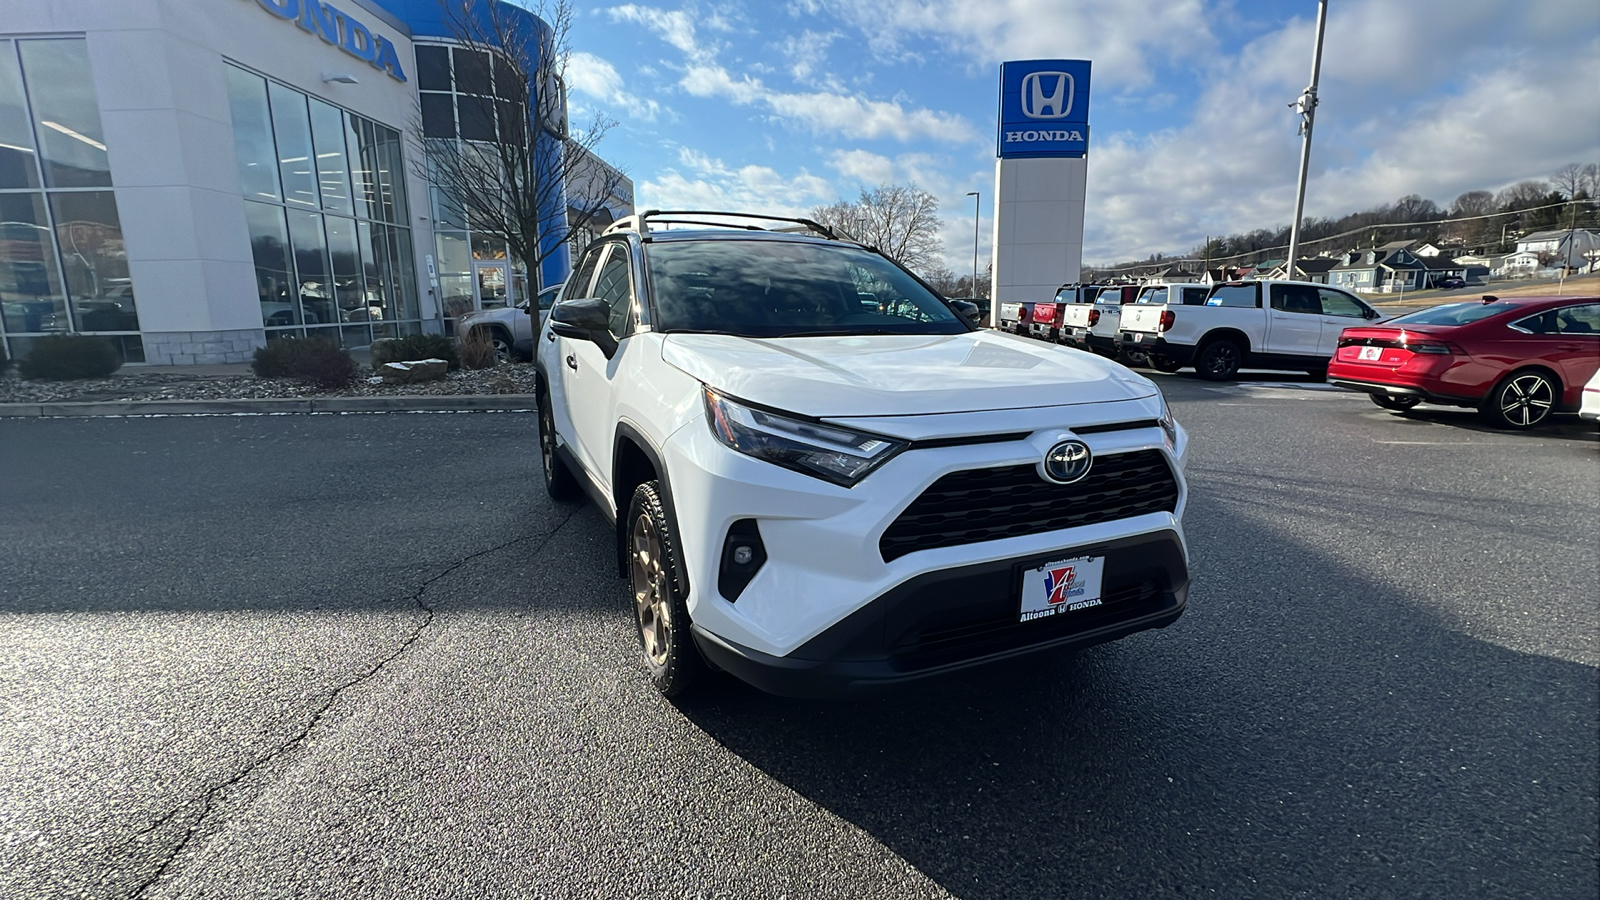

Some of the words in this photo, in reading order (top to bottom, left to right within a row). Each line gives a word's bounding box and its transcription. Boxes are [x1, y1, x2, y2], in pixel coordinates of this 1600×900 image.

[1005, 130, 1084, 143] HONDA
[1020, 608, 1055, 622] Altoona
[1069, 599, 1103, 612] HONDA
